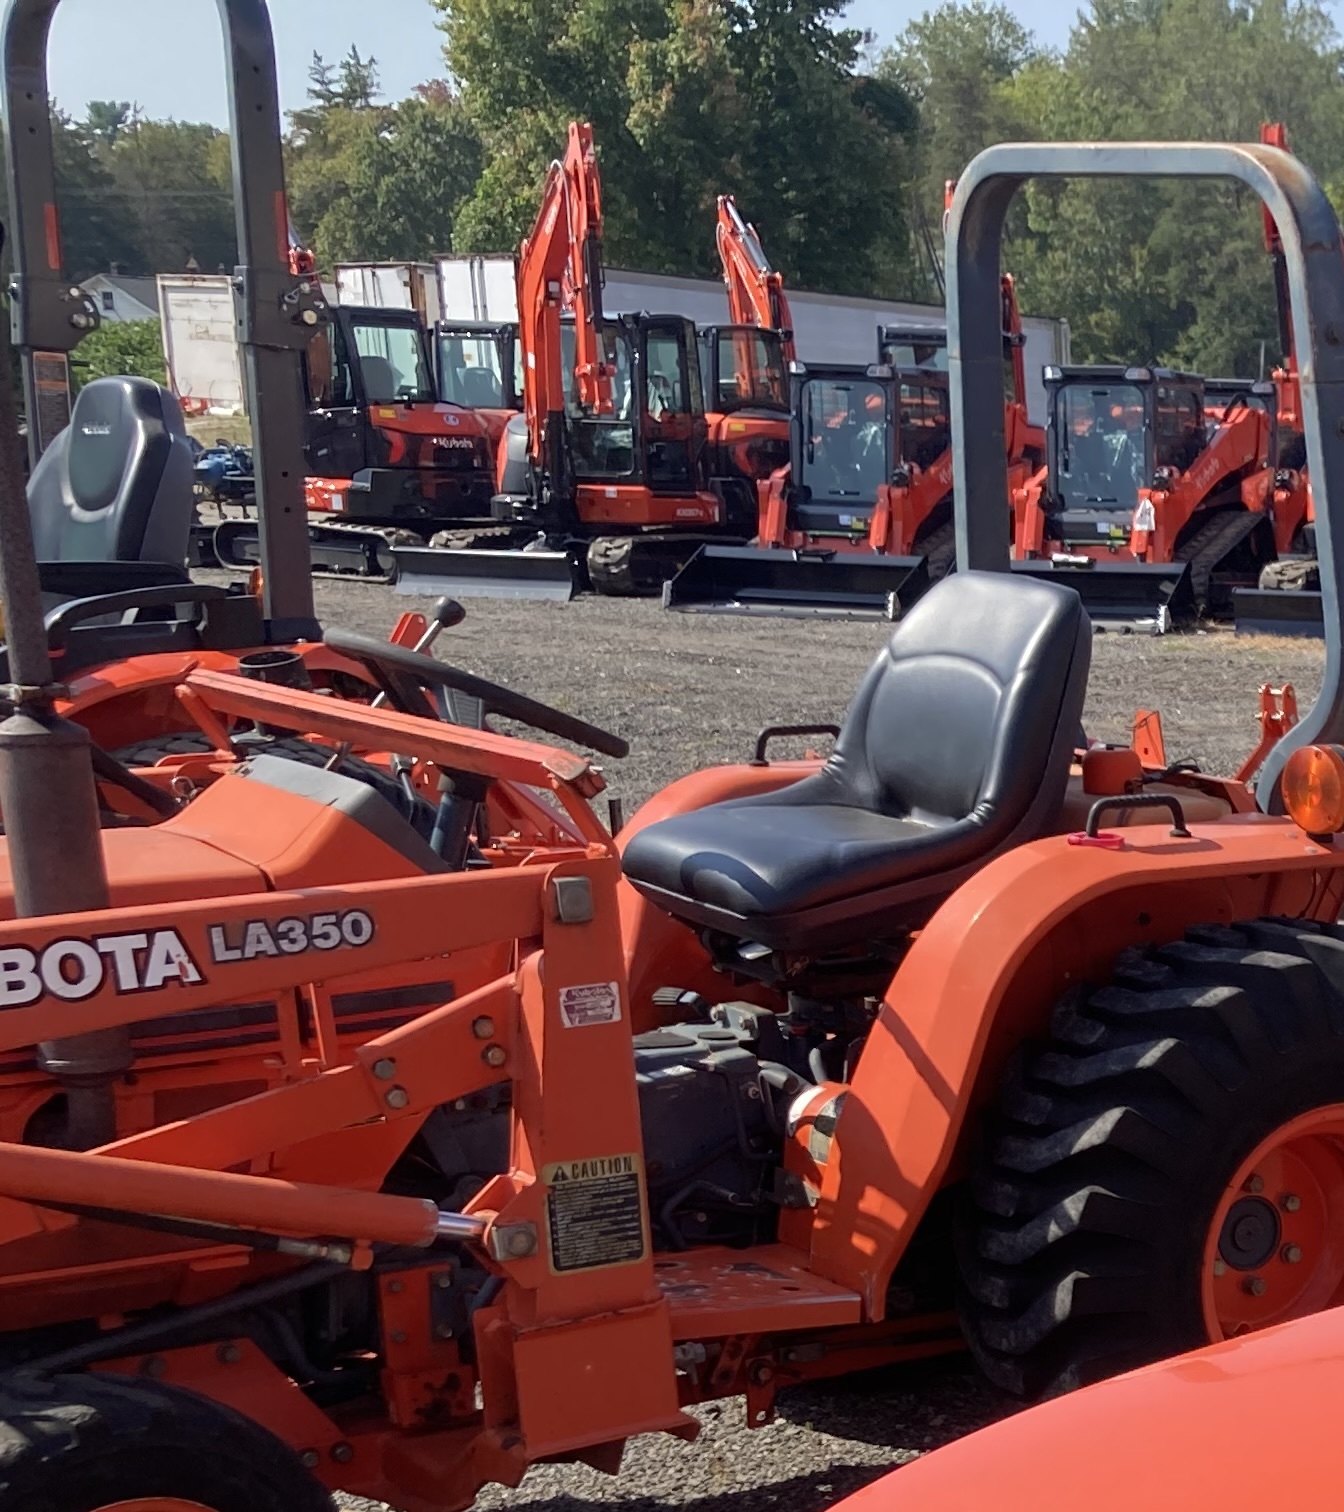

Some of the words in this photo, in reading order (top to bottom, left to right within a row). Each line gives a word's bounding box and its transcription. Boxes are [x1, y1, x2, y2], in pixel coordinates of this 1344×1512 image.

[438, 437, 473, 449] Kubota
[208, 909, 375, 965] LA350
[571, 1156, 633, 1180] CAUTION
